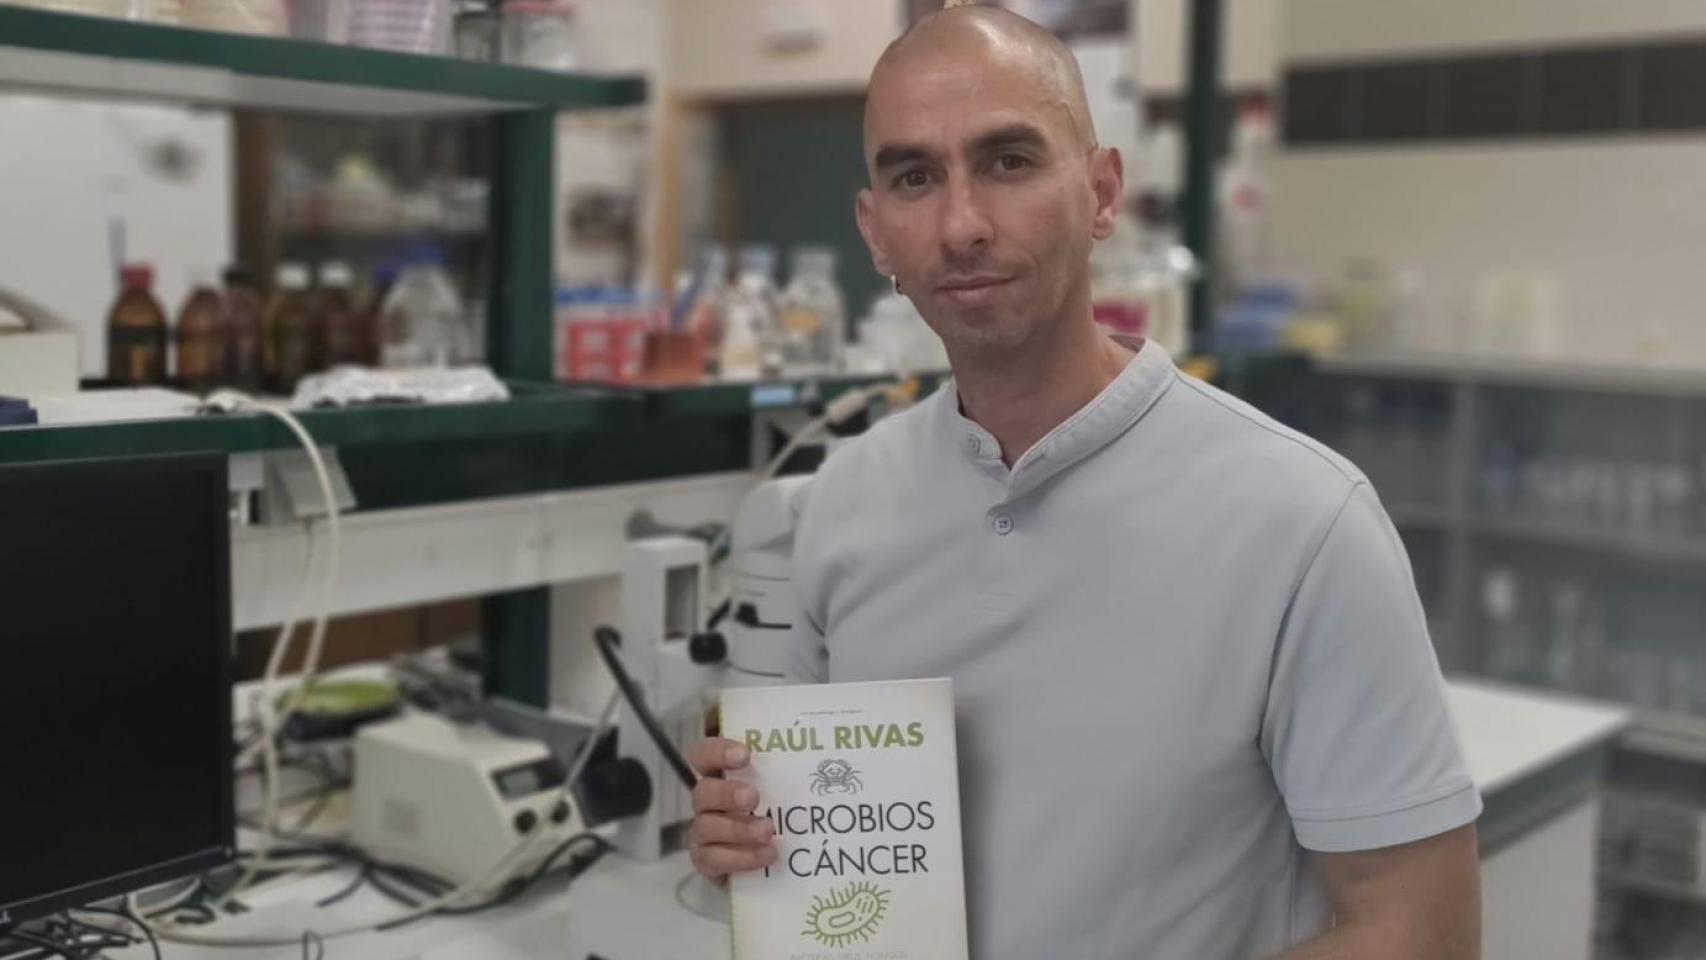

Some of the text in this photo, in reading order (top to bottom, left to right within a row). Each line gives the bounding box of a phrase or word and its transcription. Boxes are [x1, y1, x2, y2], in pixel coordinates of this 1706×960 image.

[745, 720, 924, 752] RAÚL RIVAS
[788, 839, 928, 878] CÁNCER
